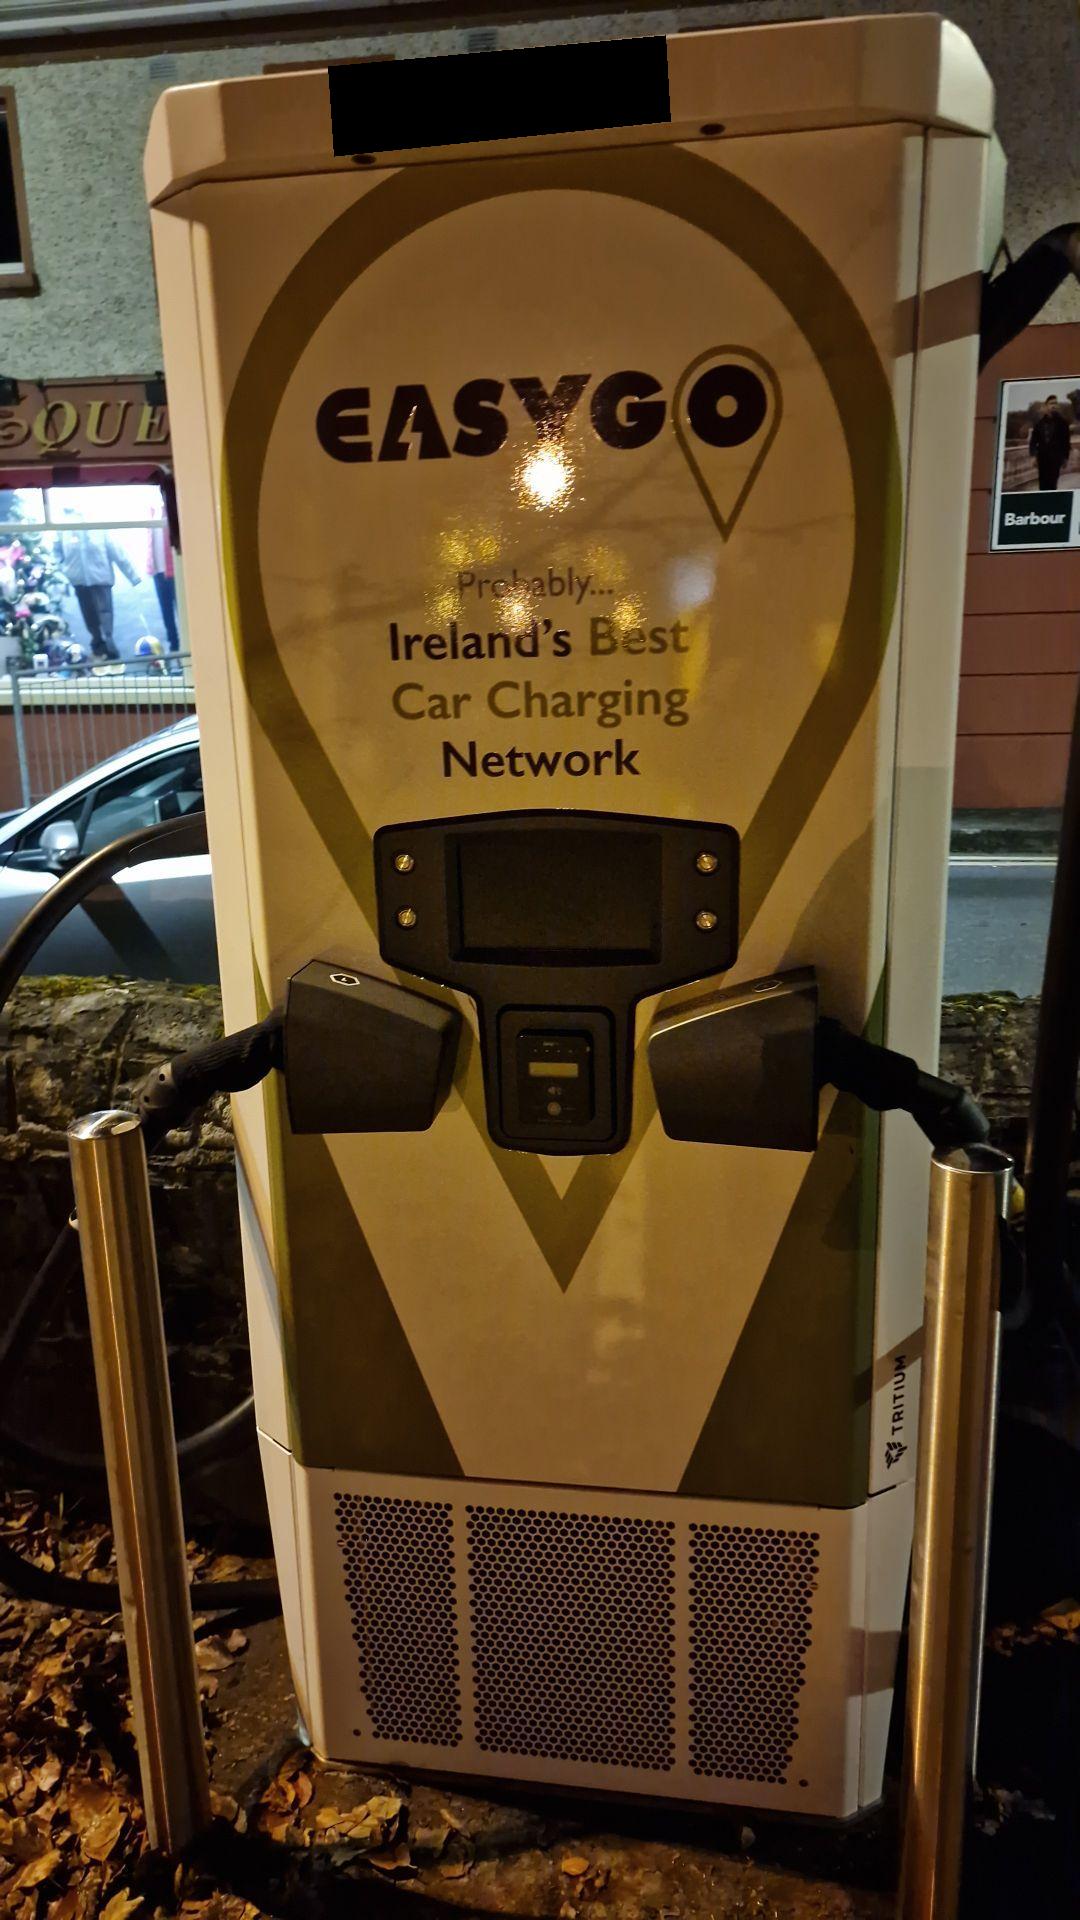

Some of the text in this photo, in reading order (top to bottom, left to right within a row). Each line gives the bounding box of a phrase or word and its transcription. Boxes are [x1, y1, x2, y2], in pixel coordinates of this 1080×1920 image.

[315, 364, 767, 463] EASYGO
[1004, 511, 1066, 526] Barbour
[456, 567, 614, 605] Probably...
[389, 616, 689, 661] Ireland's Best
[392, 679, 690, 728] Car Charging
[442, 738, 641, 778] Network
[891, 1355, 907, 1436] TRITIUM
